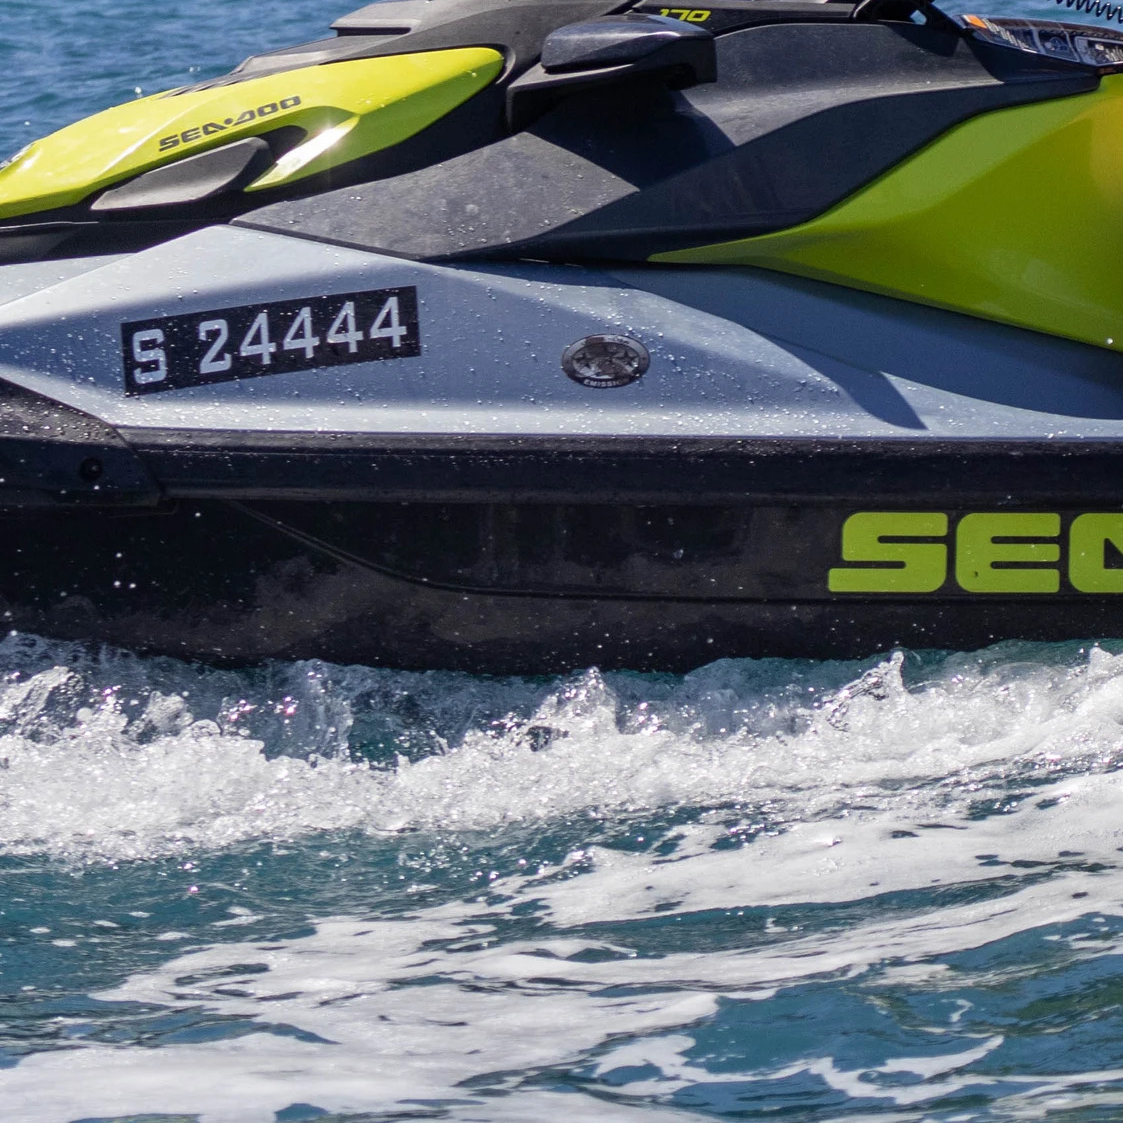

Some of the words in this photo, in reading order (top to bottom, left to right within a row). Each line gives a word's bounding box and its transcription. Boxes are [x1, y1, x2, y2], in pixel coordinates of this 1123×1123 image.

[660, 8, 712, 22] 170
[132, 328, 167, 384] S
[199, 296, 408, 374] 24444
